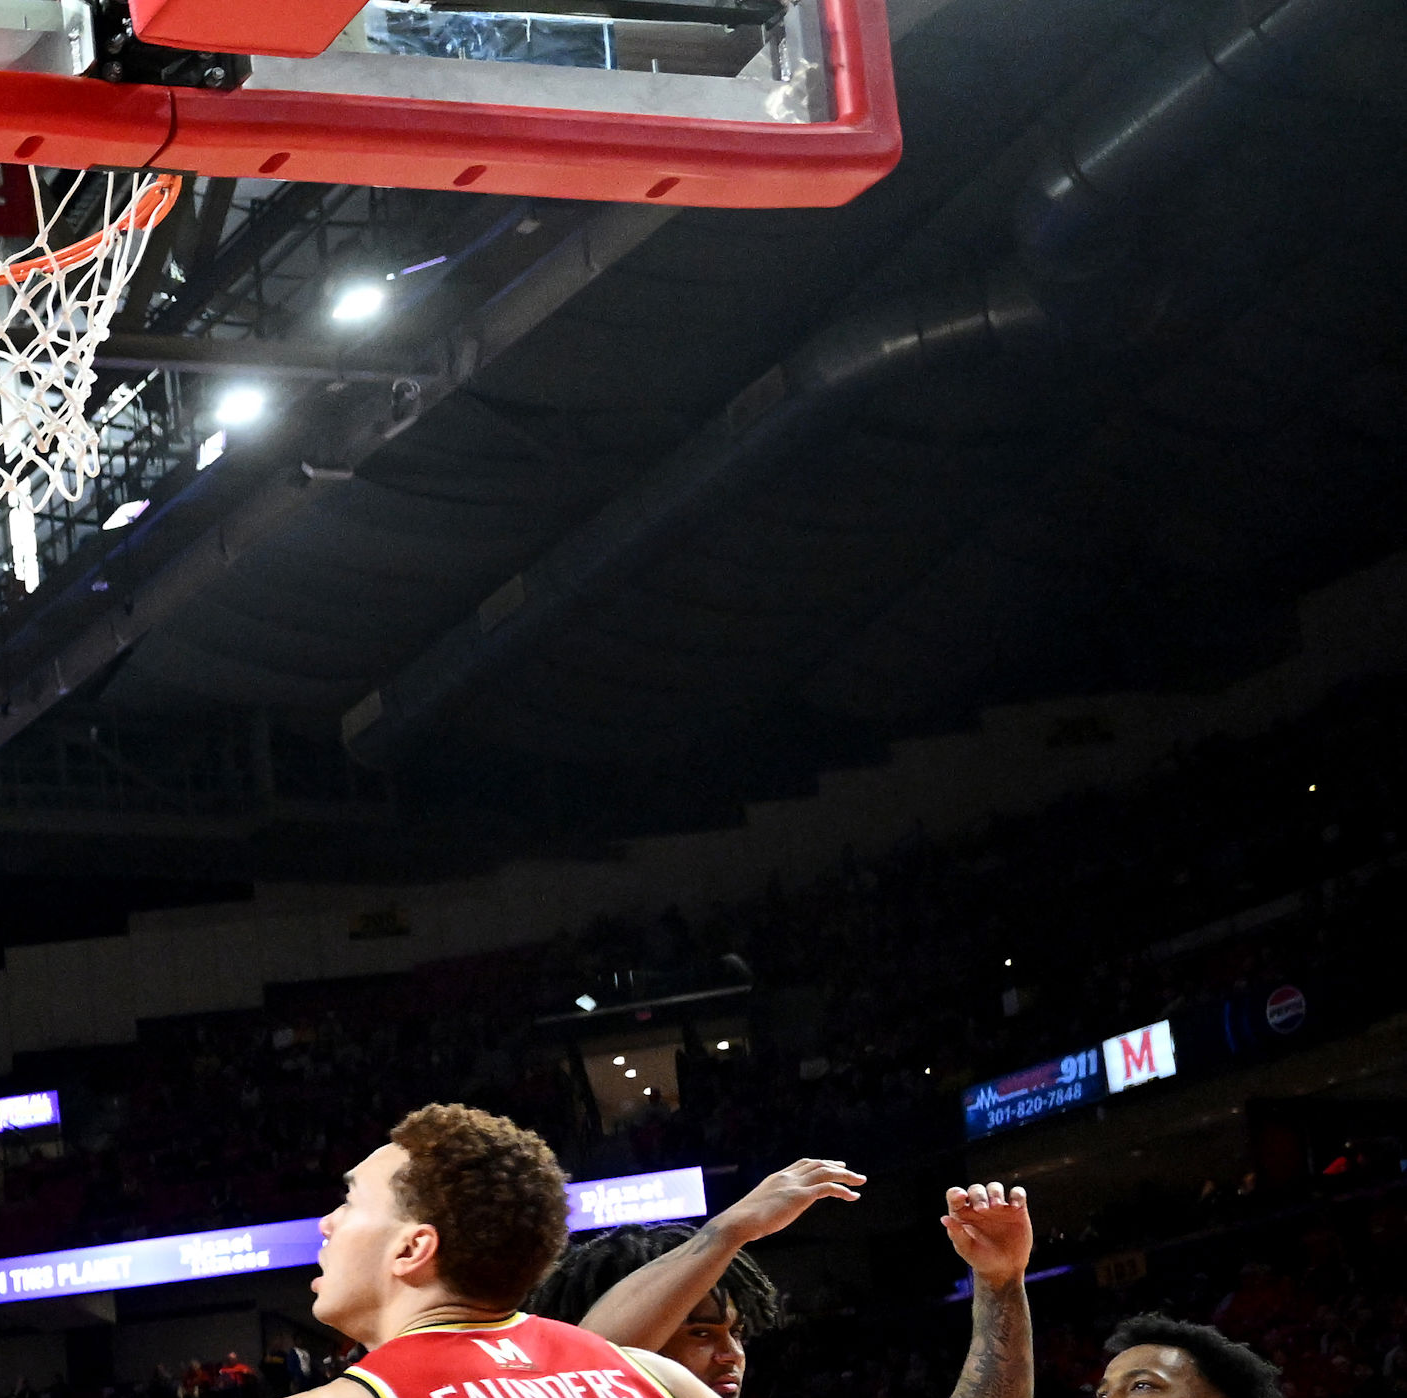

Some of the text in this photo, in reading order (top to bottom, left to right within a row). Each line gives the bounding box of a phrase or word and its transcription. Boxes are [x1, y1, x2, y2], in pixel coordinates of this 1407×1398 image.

[1055, 1048, 1098, 1084] 911
[1118, 1030, 1156, 1081] M
[987, 1081, 1083, 1129] 301-820-7848
[9, 1265, 55, 1294] THIS
[56, 1255, 133, 1288] PLANET
[470, 1337, 534, 1366] M
